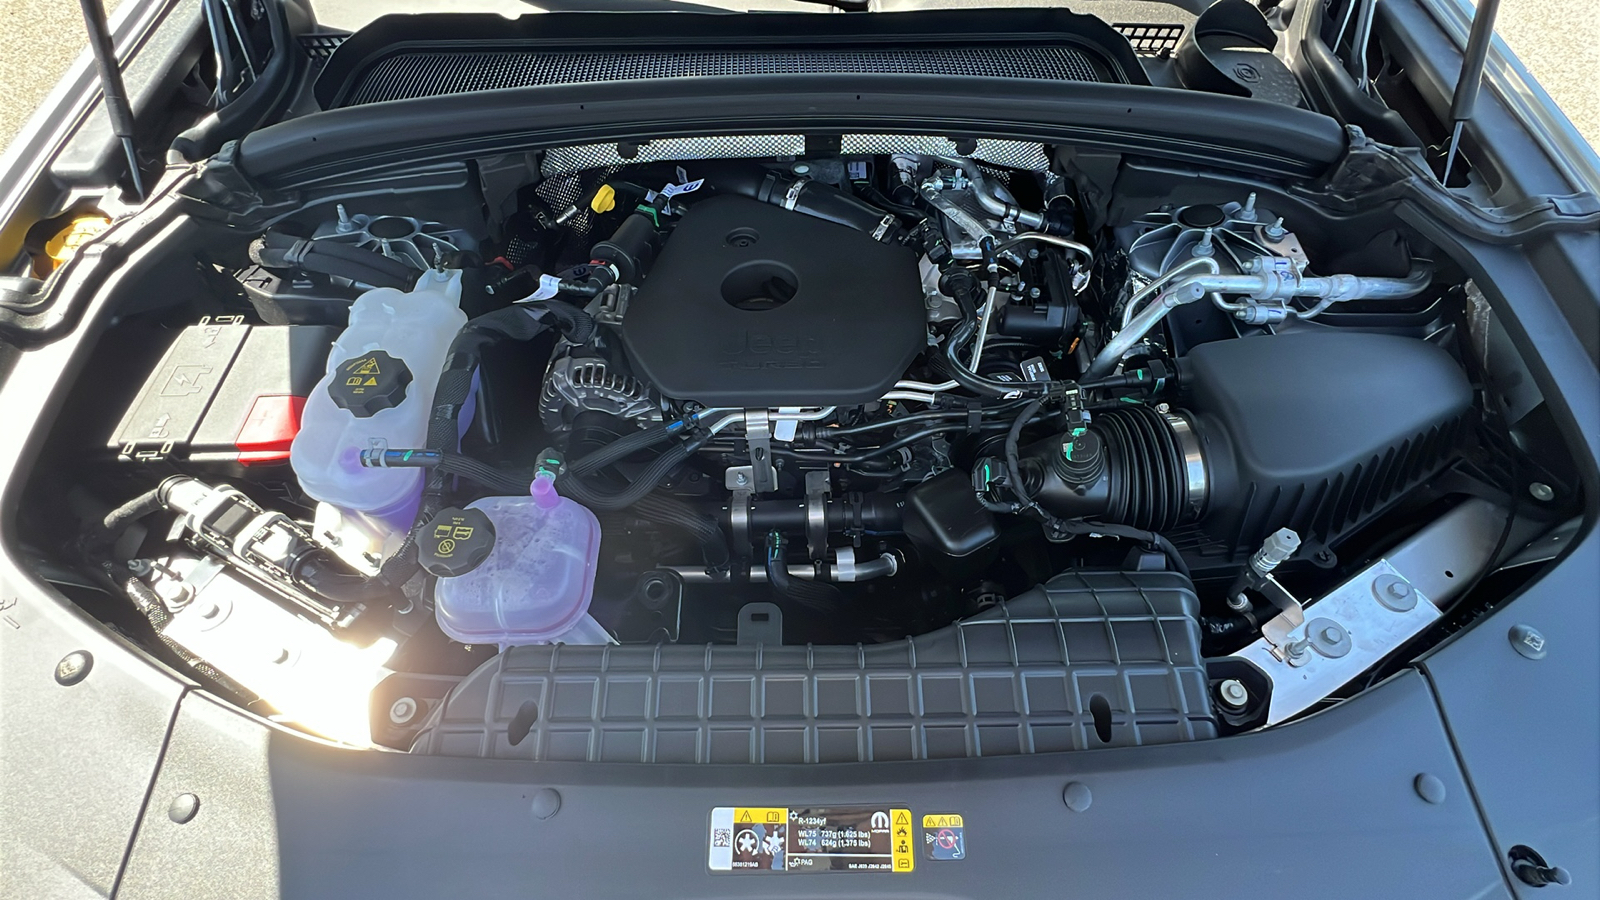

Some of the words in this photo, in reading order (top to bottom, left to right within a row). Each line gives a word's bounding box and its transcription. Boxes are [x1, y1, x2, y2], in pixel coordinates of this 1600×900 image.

[720, 329, 821, 358] Jeep
[798, 817, 827, 826] R-1234yf
[821, 830, 837, 839] 737g
[858, 830, 871, 839] lbs)
[821, 839, 837, 848] 624g
[858, 839, 871, 848] lbs)
